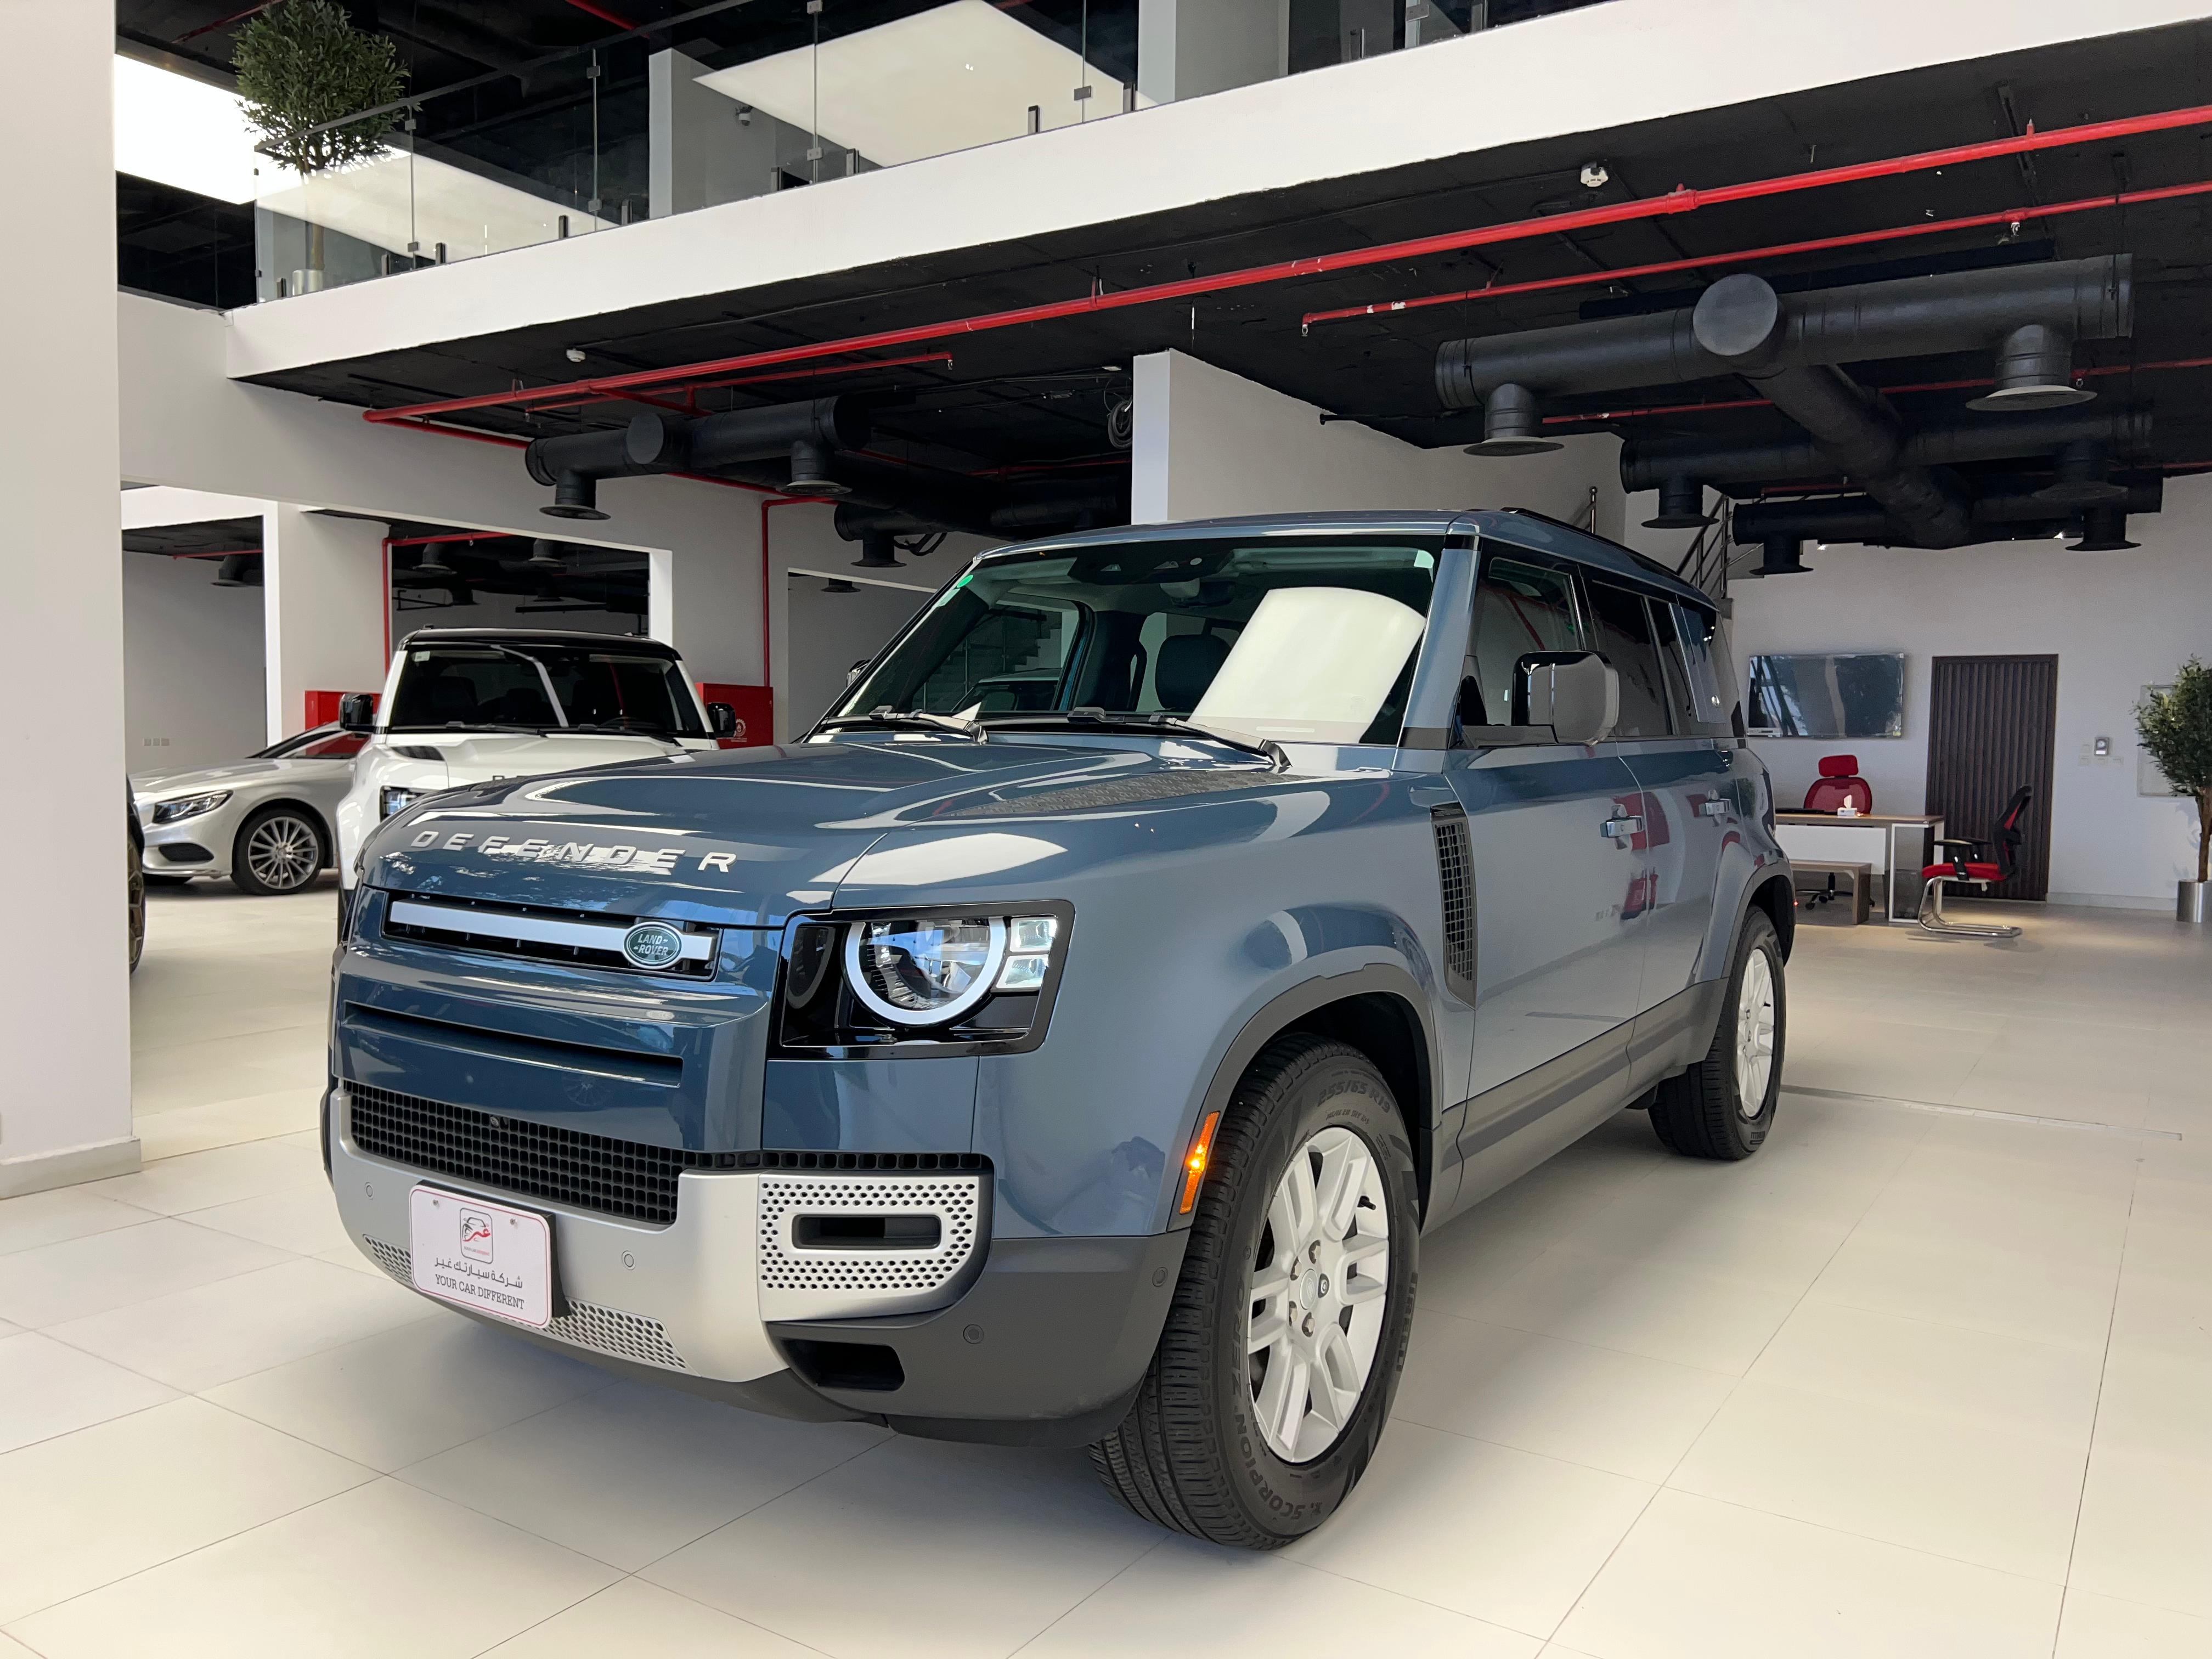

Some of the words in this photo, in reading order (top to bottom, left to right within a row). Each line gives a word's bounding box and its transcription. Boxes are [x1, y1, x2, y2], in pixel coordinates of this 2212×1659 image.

[410, 831, 738, 873] DEFENDER
[637, 944, 669, 956] ROVER
[434, 1257, 453, 1269] غير
[454, 1261, 490, 1279] سيارتك
[435, 1274, 457, 1290] YOUR
[459, 1281, 476, 1296] CAR
[477, 1286, 525, 1310] DIFFERENT
[491, 1270, 523, 1288] شركة
[1232, 1277, 1245, 1398] ZERO
[1235, 1414, 1307, 1520] SCORPION
